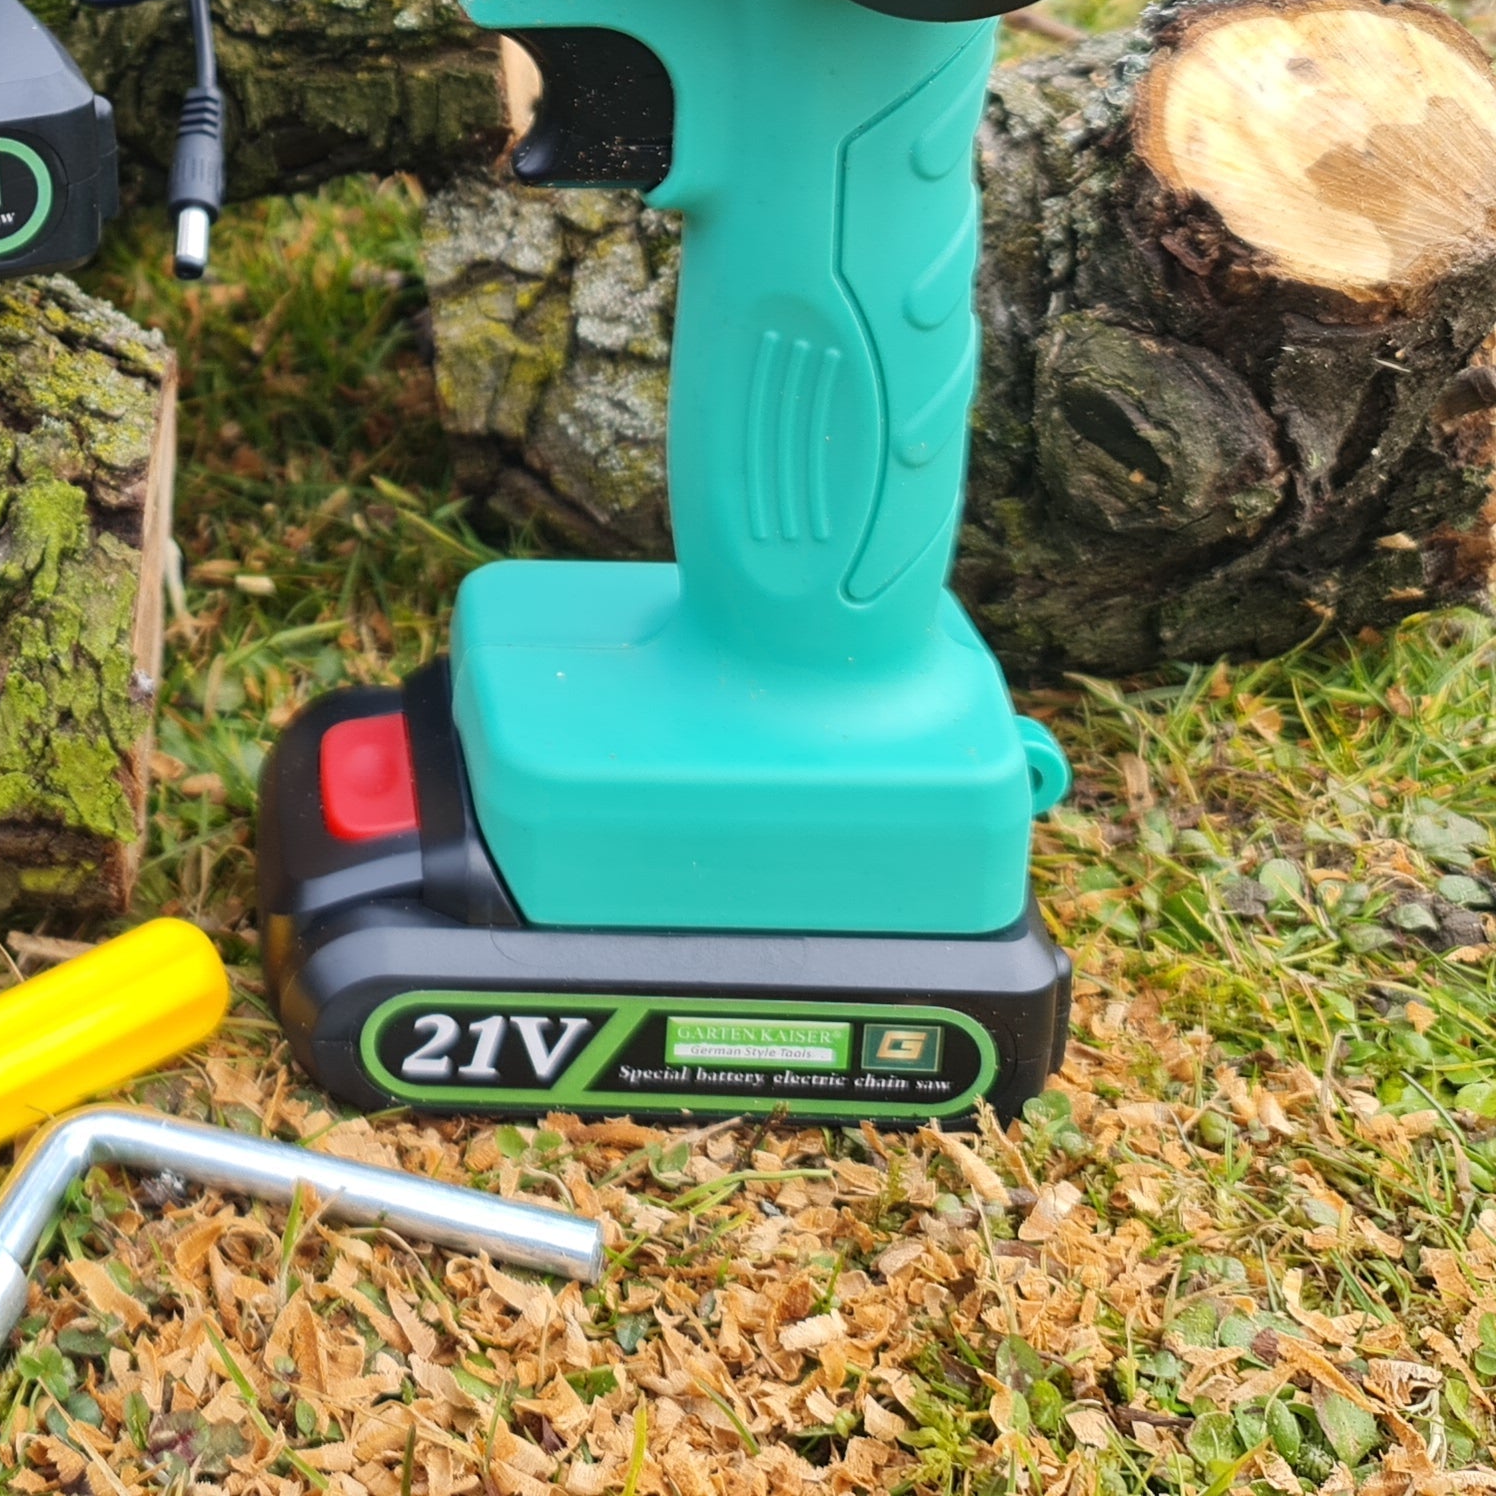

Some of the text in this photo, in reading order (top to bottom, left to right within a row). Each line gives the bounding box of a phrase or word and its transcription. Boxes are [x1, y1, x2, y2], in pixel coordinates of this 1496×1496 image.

[677, 1025, 755, 1041] GARTEN
[401, 1013, 591, 1082] 21V
[690, 1045, 812, 1059] German Style Tools
[618, 1064, 951, 1092] Special battery electric chain saw
